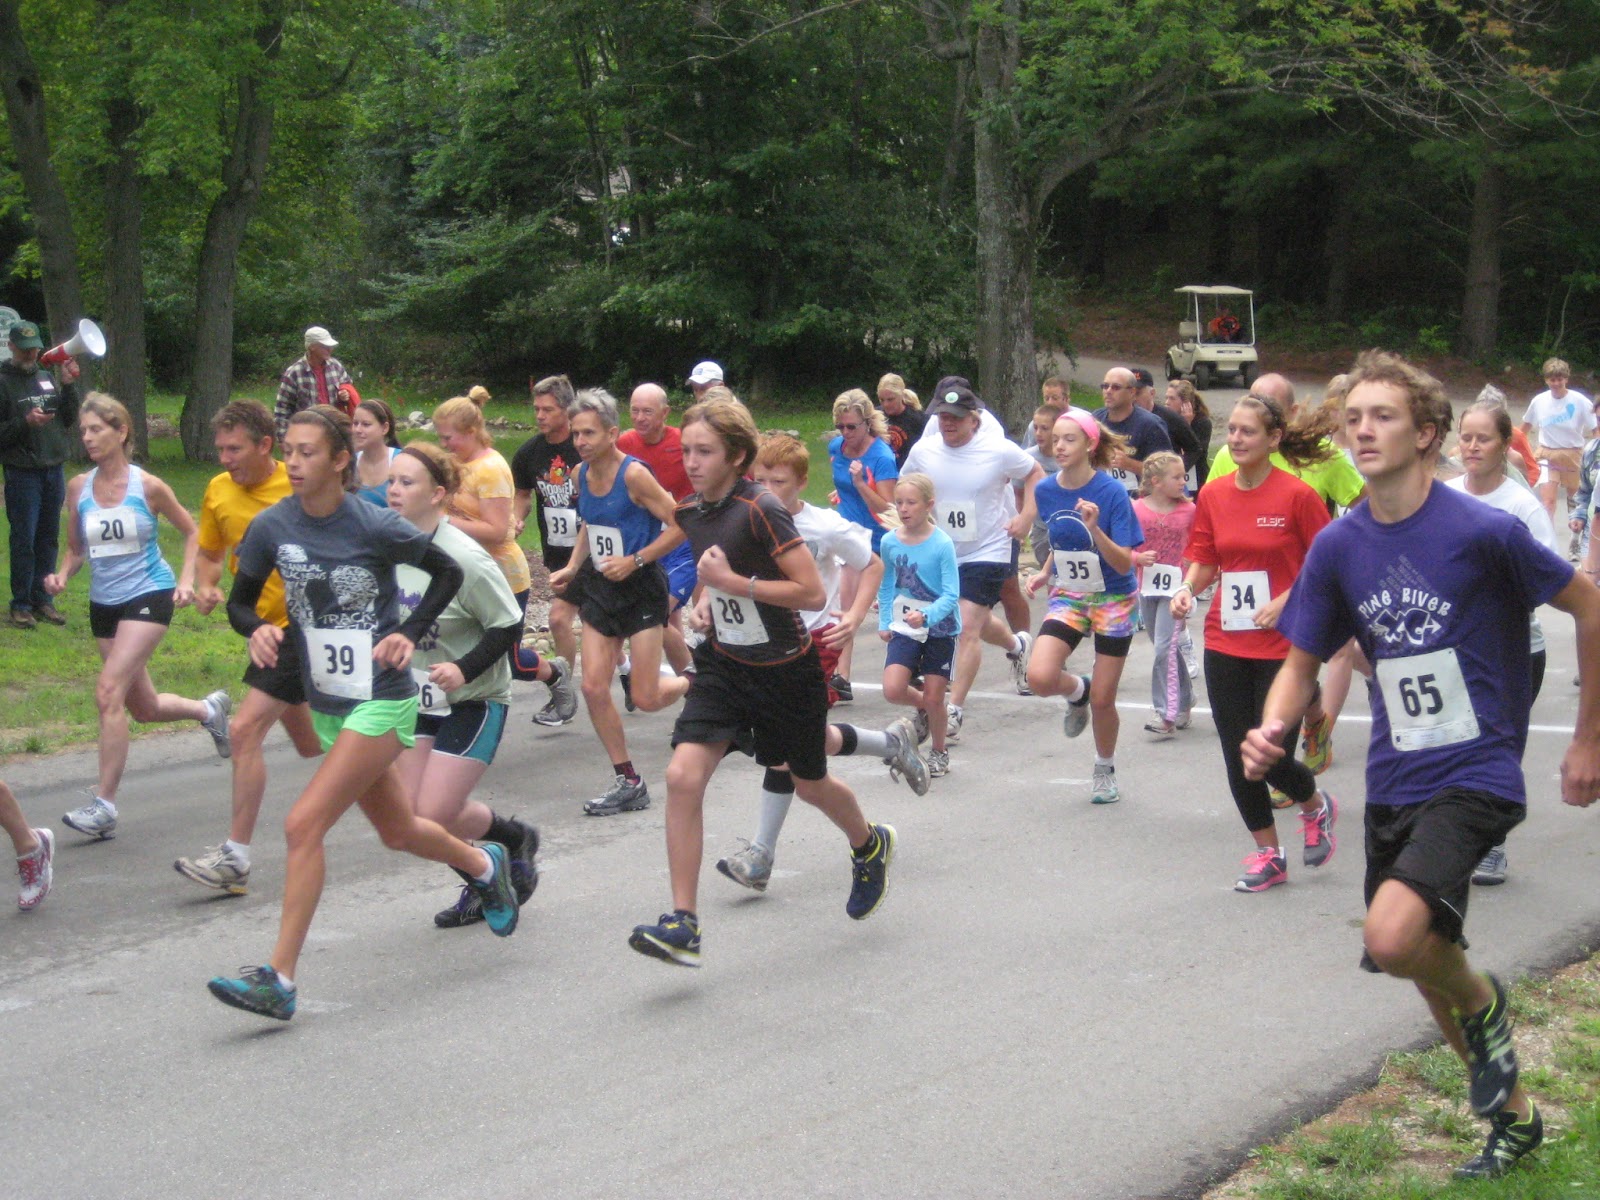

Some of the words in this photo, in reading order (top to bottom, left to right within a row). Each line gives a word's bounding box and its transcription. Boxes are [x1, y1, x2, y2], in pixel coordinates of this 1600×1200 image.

[100, 519, 124, 541] 20
[552, 517, 567, 535] 33
[947, 511, 966, 528] 48
[597, 536, 613, 556] 59
[1067, 561, 1090, 580] 35
[1152, 573, 1172, 590] 49
[1231, 585, 1256, 610] 34
[1358, 590, 1392, 619] PINE
[1402, 588, 1452, 616] RIVER
[318, 612, 376, 627] TRACK
[716, 597, 745, 625] 28
[324, 644, 355, 675] 39
[1398, 673, 1443, 717] 65
